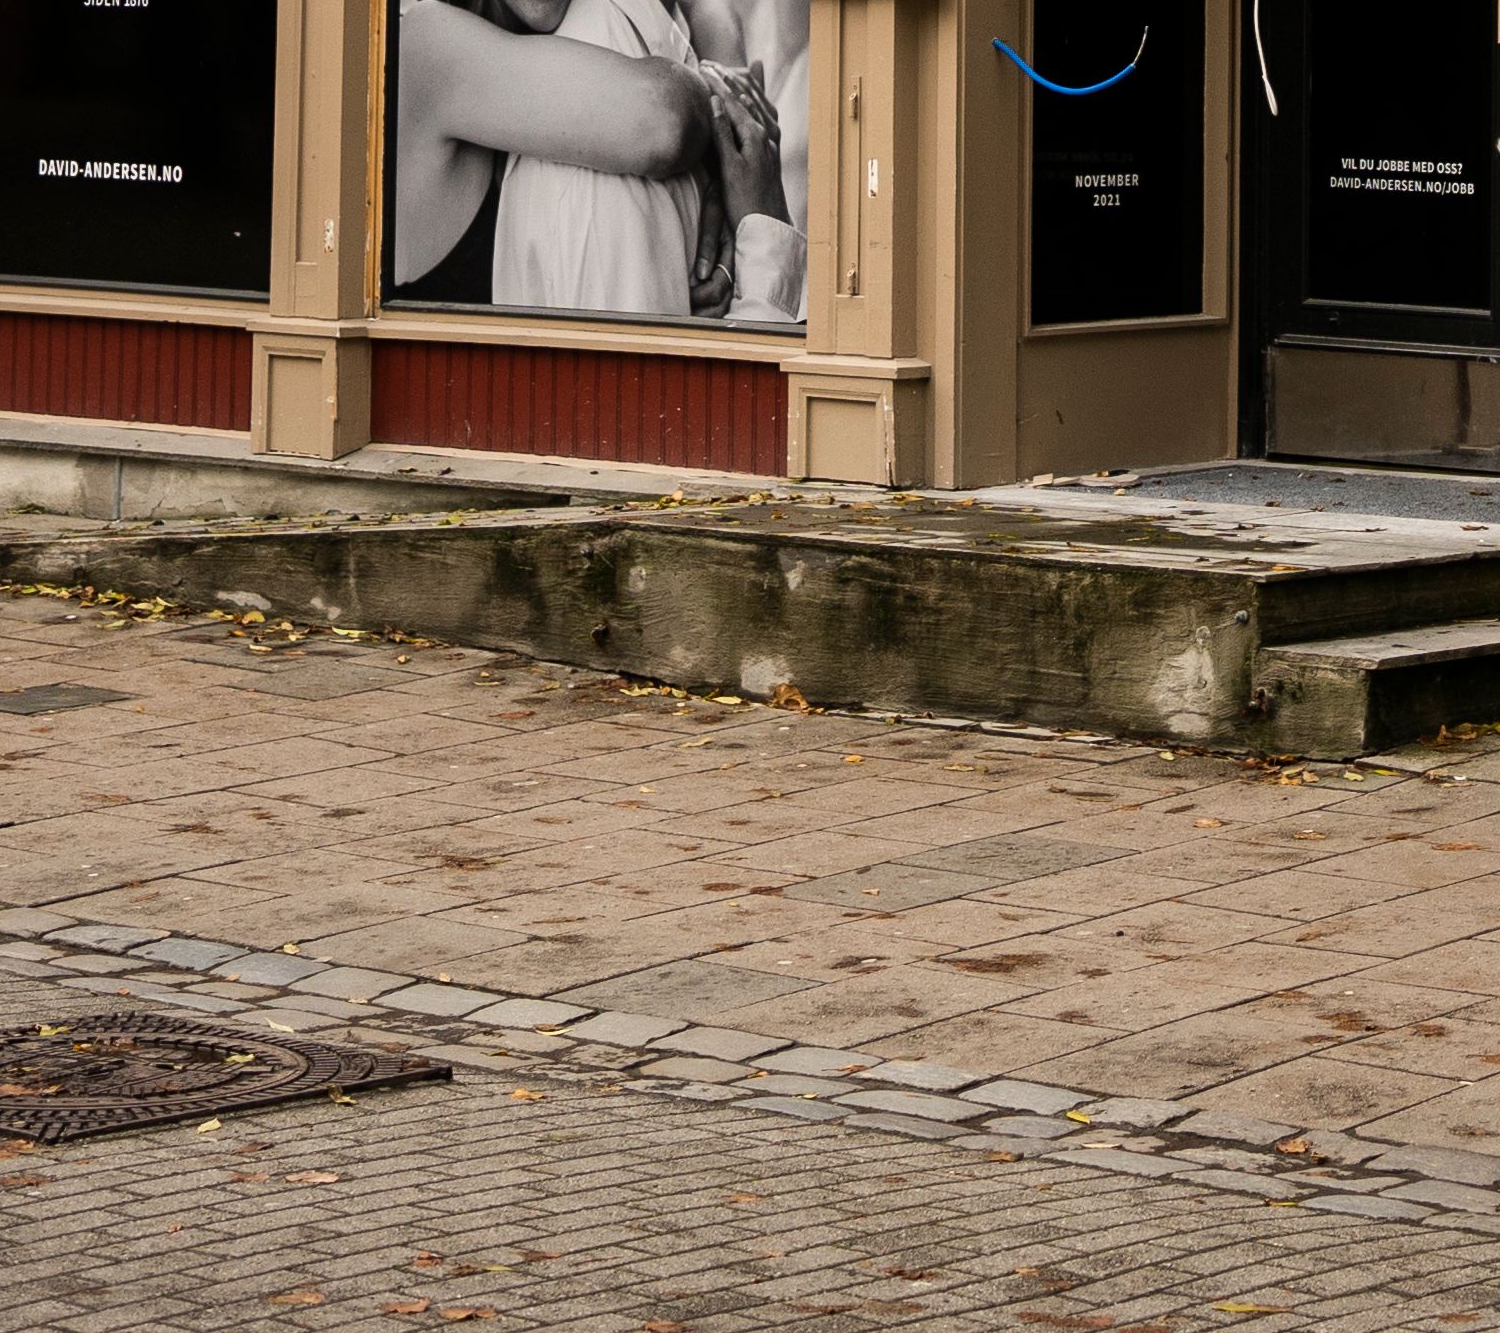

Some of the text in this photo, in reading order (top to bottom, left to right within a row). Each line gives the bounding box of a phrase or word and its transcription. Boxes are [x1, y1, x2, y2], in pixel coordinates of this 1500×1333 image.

[38, 158, 183, 183] DAVID-ANDERSEN.NO
[1341, 157, 1463, 175] VIL DU JOBBE MED OSS?
[1075, 173, 1140, 188] NOVEMBER
[1330, 176, 1475, 195] DAVID-ANDERSEN.NO/JOBB
[1093, 193, 1122, 207] 2021
